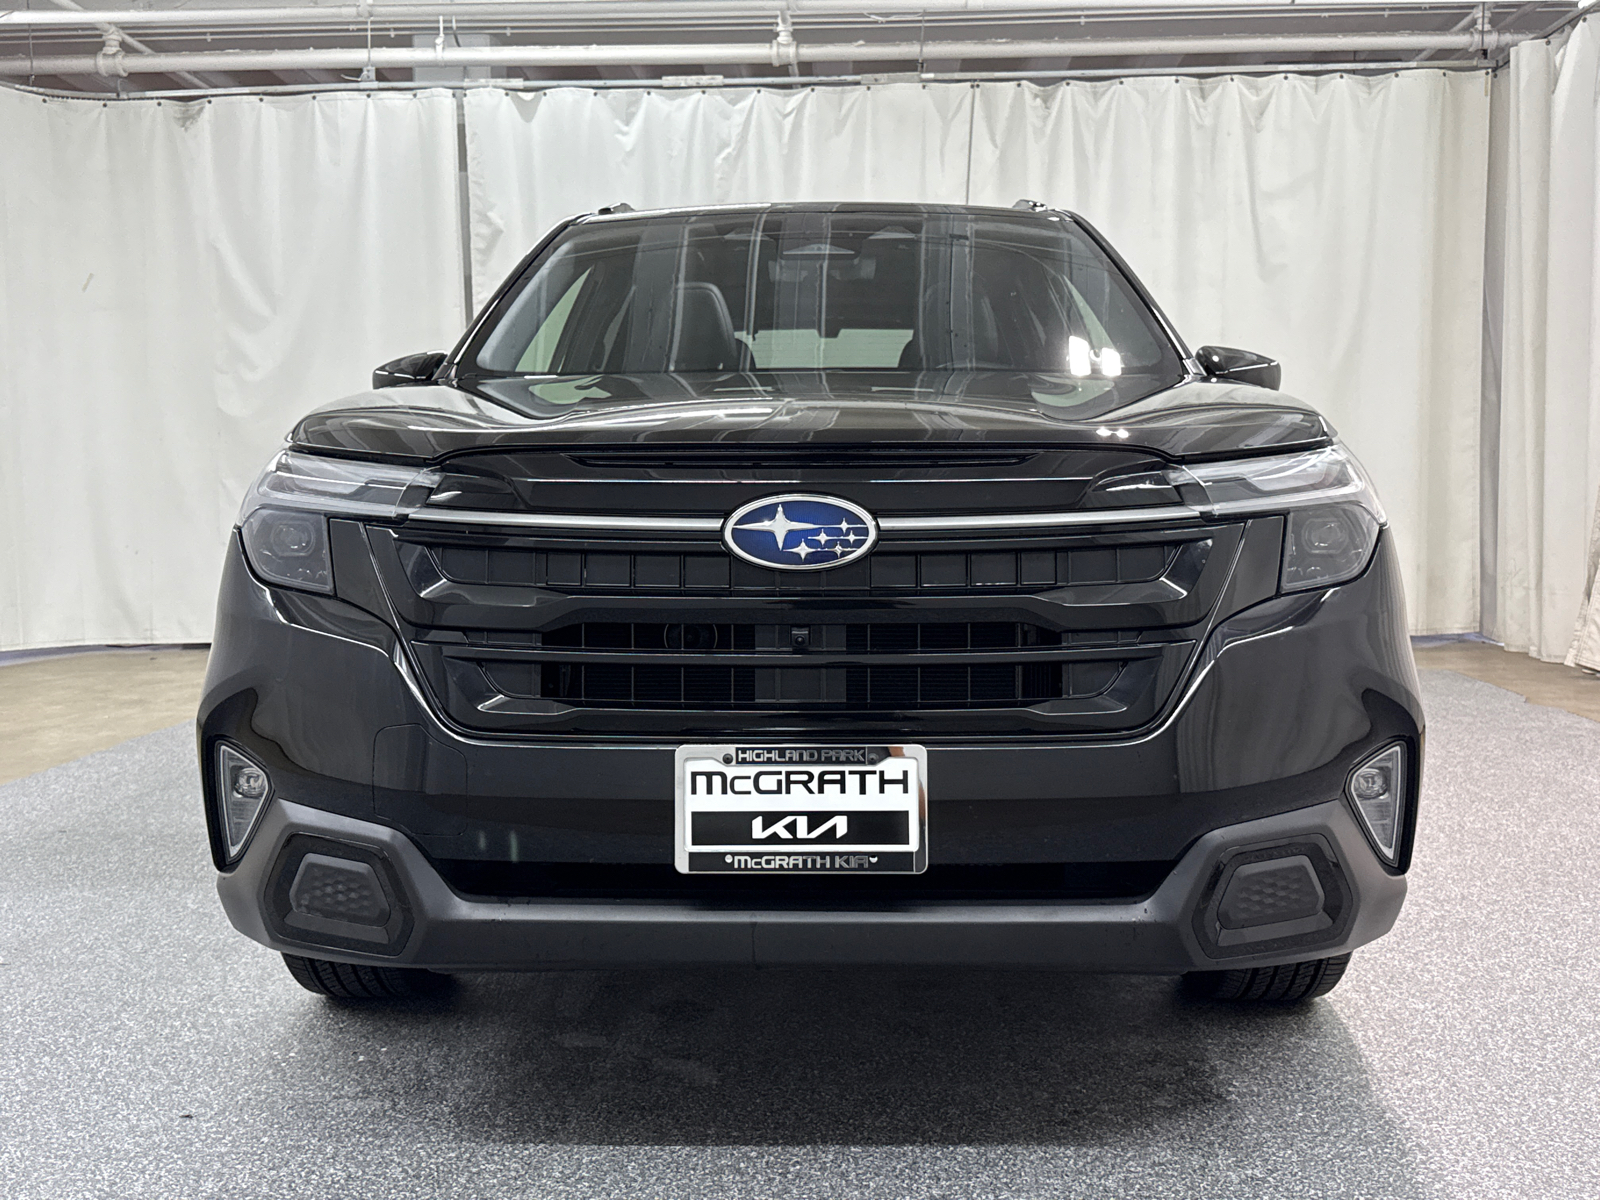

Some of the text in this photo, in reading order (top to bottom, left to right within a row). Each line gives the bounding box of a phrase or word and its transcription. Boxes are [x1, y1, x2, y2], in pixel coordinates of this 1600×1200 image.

[738, 749, 866, 762] HIGHLAND PARK
[690, 770, 909, 795] McGRATH
[751, 815, 848, 839] KIA
[733, 855, 869, 869] McGRATH KIA
